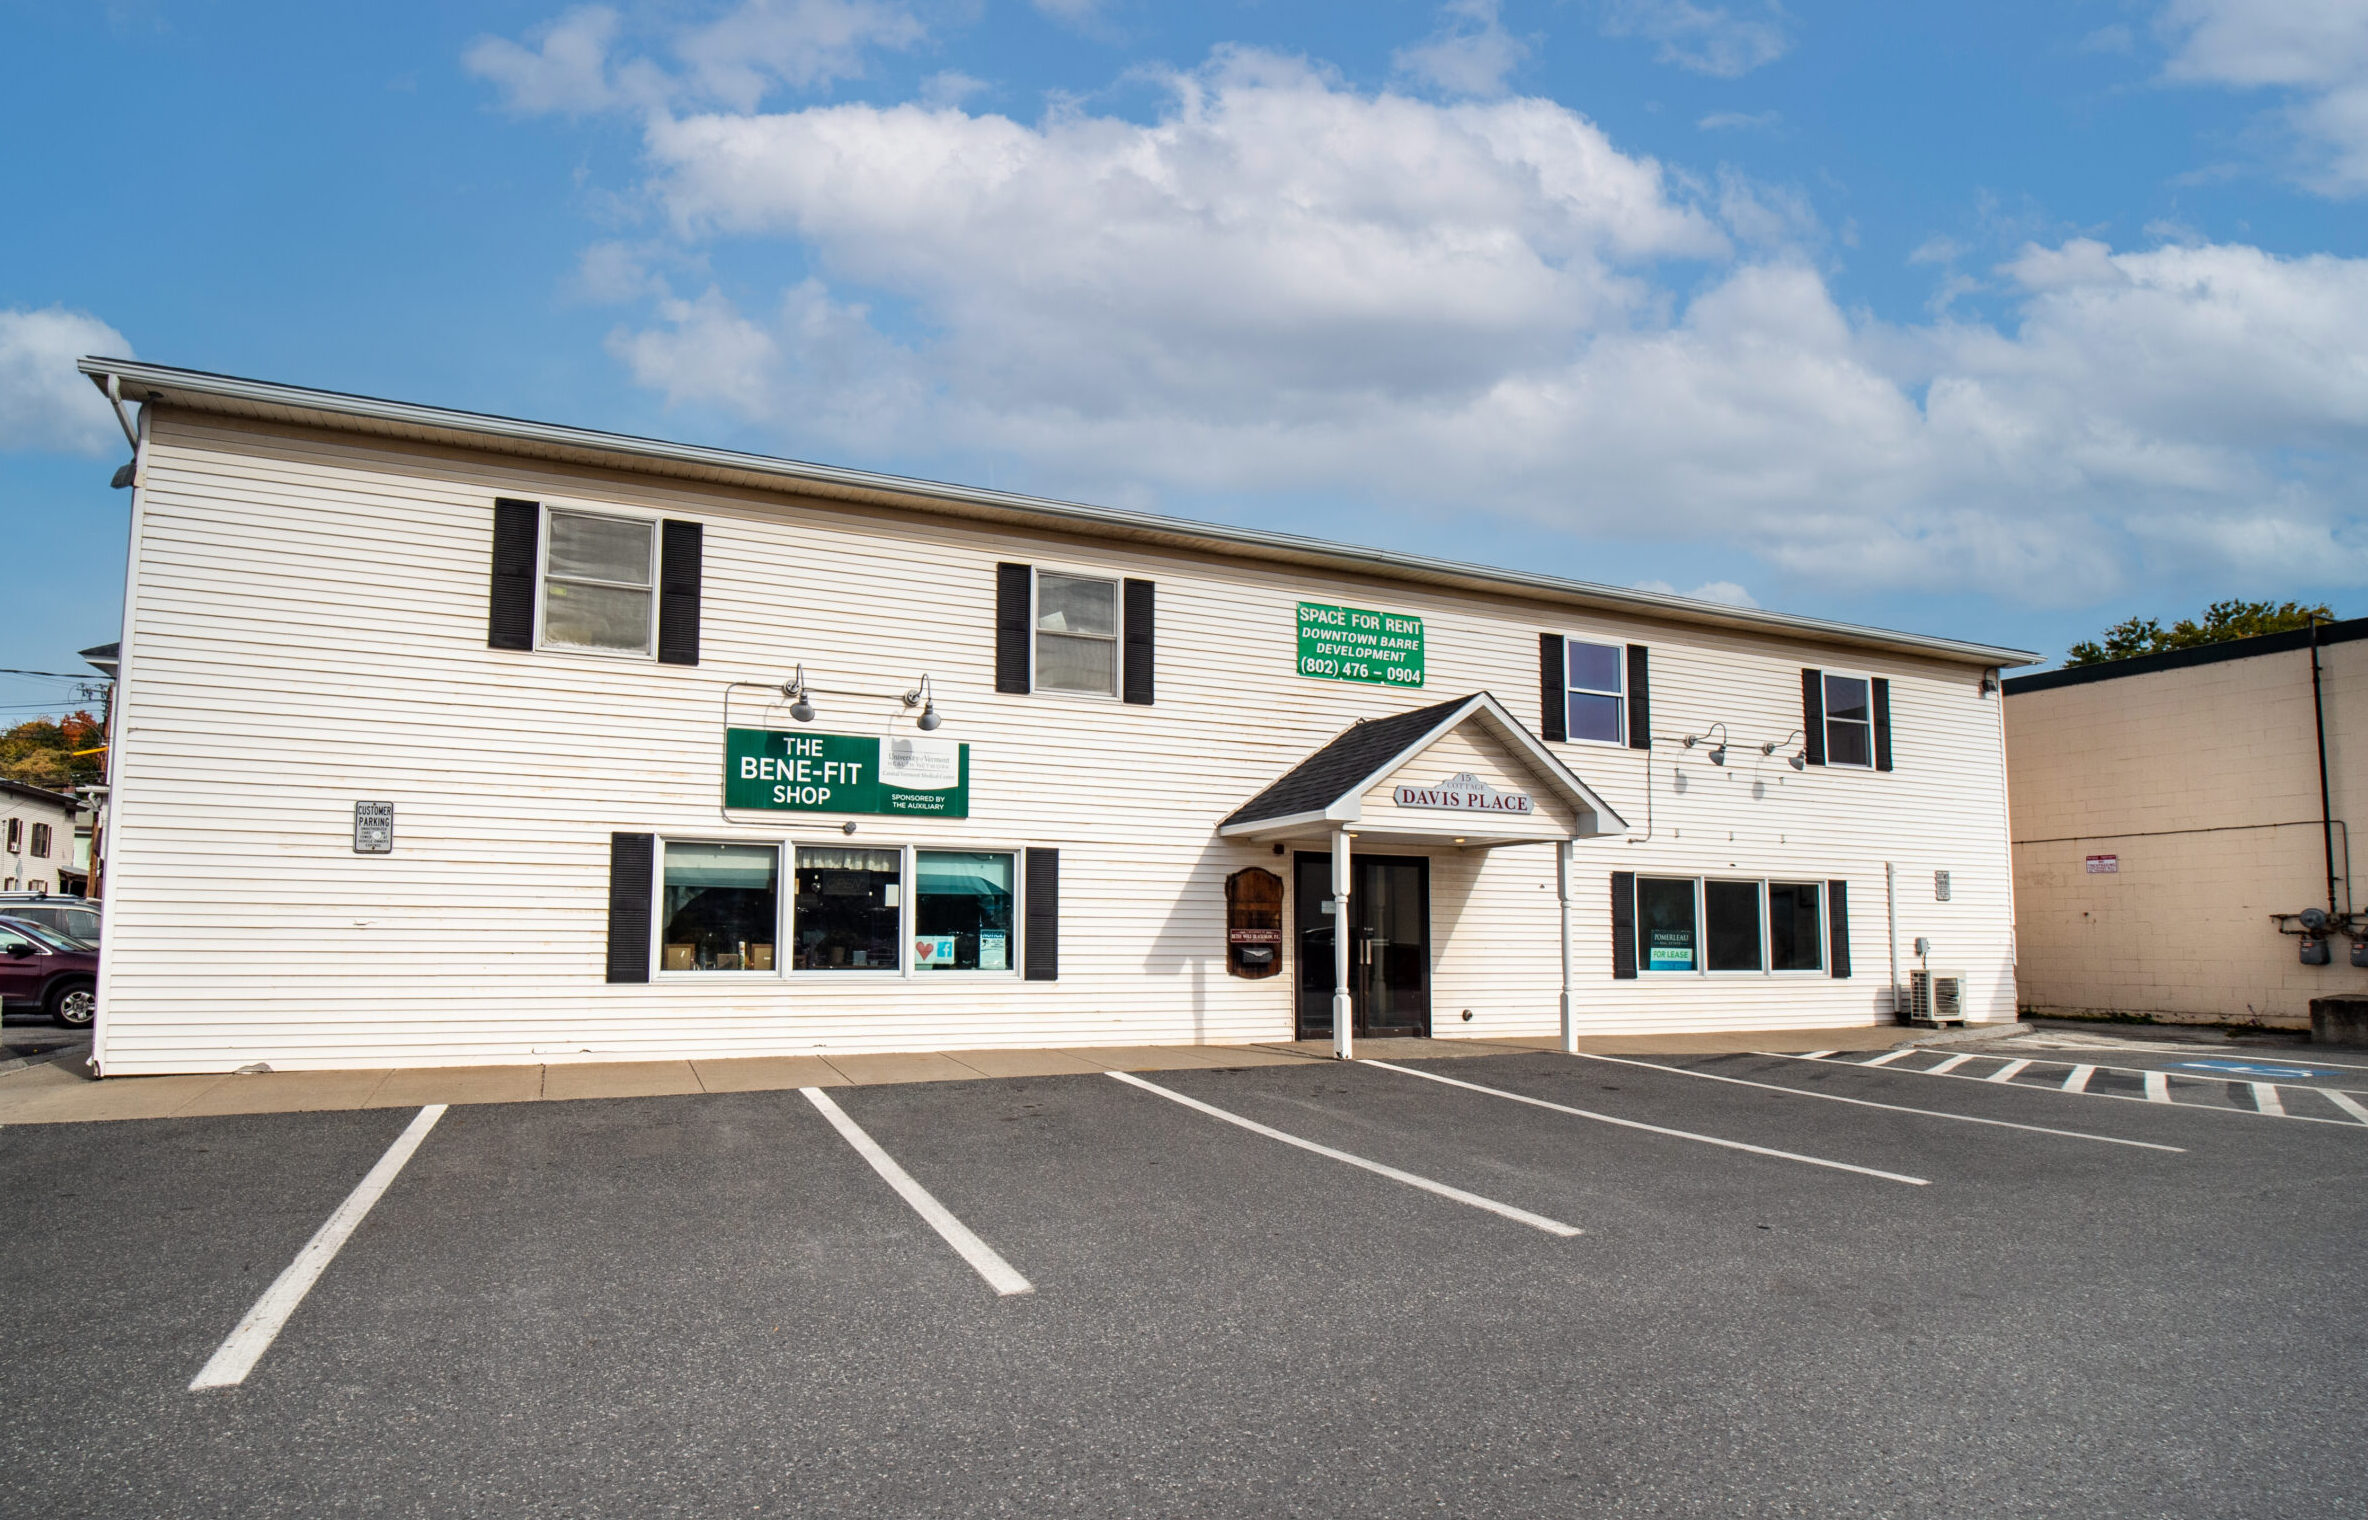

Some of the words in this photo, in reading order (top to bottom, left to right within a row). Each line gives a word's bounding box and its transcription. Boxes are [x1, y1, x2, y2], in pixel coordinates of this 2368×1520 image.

[1299, 607, 1346, 626] SPACE
[1351, 614, 1380, 631] FOR
[1385, 618, 1421, 635] RENT
[1302, 627, 1377, 646] DOWNTOWN
[1380, 636, 1420, 651] BARRE
[1316, 643, 1406, 662] DEVELOPMENT
[1300, 656, 1339, 678] (802)
[1342, 662, 1369, 678] 476
[1386, 667, 1421, 683] 0904
[783, 737, 824, 757] THE
[740, 756, 863, 785] BENE-FIT
[1461, 774, 1472, 782] 15
[1447, 783, 1485, 791] COTTAGE
[773, 785, 831, 805] SHOP
[891, 794, 935, 802] SPONSORED
[1402, 788, 1460, 807] DAVIS
[1466, 793, 1528, 811] PLACE
[358, 806, 391, 816] CUSTOMER
[908, 802, 945, 810] AUXILIARY
[359, 817, 389, 827] PARKING
[1654, 933, 1689, 941] POMERLEAU
[1667, 951, 1688, 959] LEASE
